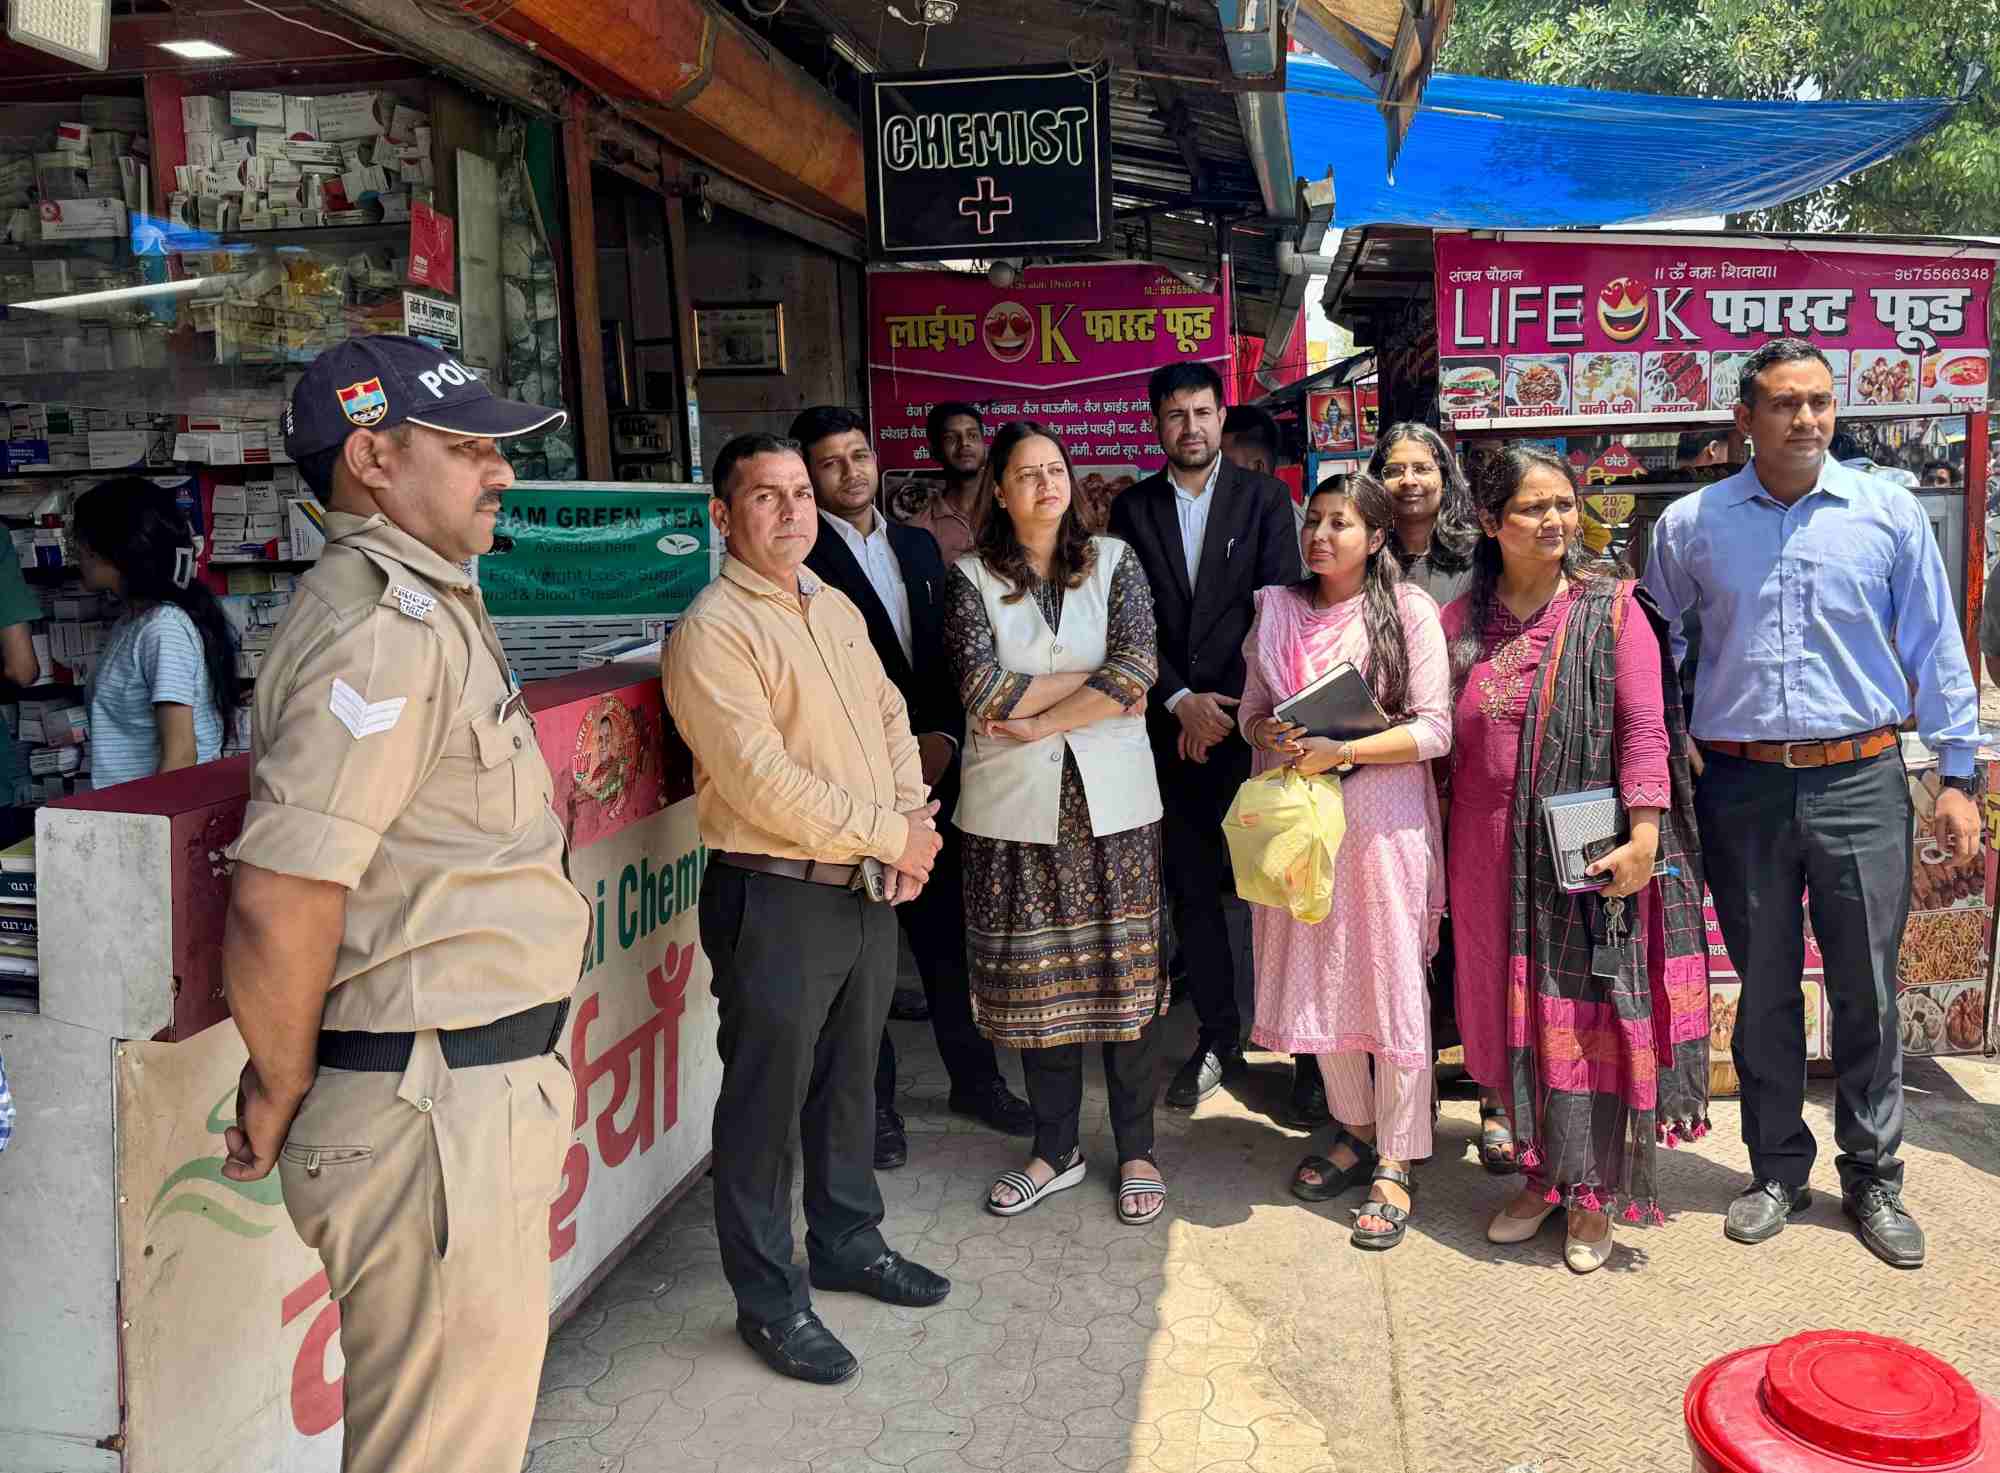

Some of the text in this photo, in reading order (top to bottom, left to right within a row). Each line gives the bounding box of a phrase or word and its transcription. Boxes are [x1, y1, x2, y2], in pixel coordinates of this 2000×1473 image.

[884, 107, 1088, 171] CHEMIST
[1449, 266, 1523, 282] संजय चौहान
[1895, 268, 1989, 281] 9675566348
[885, 304, 976, 351] लाईफ
[1082, 308, 1158, 342] फास्ट
[1162, 306, 1215, 352] फूड
[1454, 285, 1585, 345] LIFE
[1705, 288, 1972, 350] फास्ट फूड
[418, 359, 477, 399] POL
[556, 507, 641, 529] GREEN
[656, 507, 704, 529] TEA
